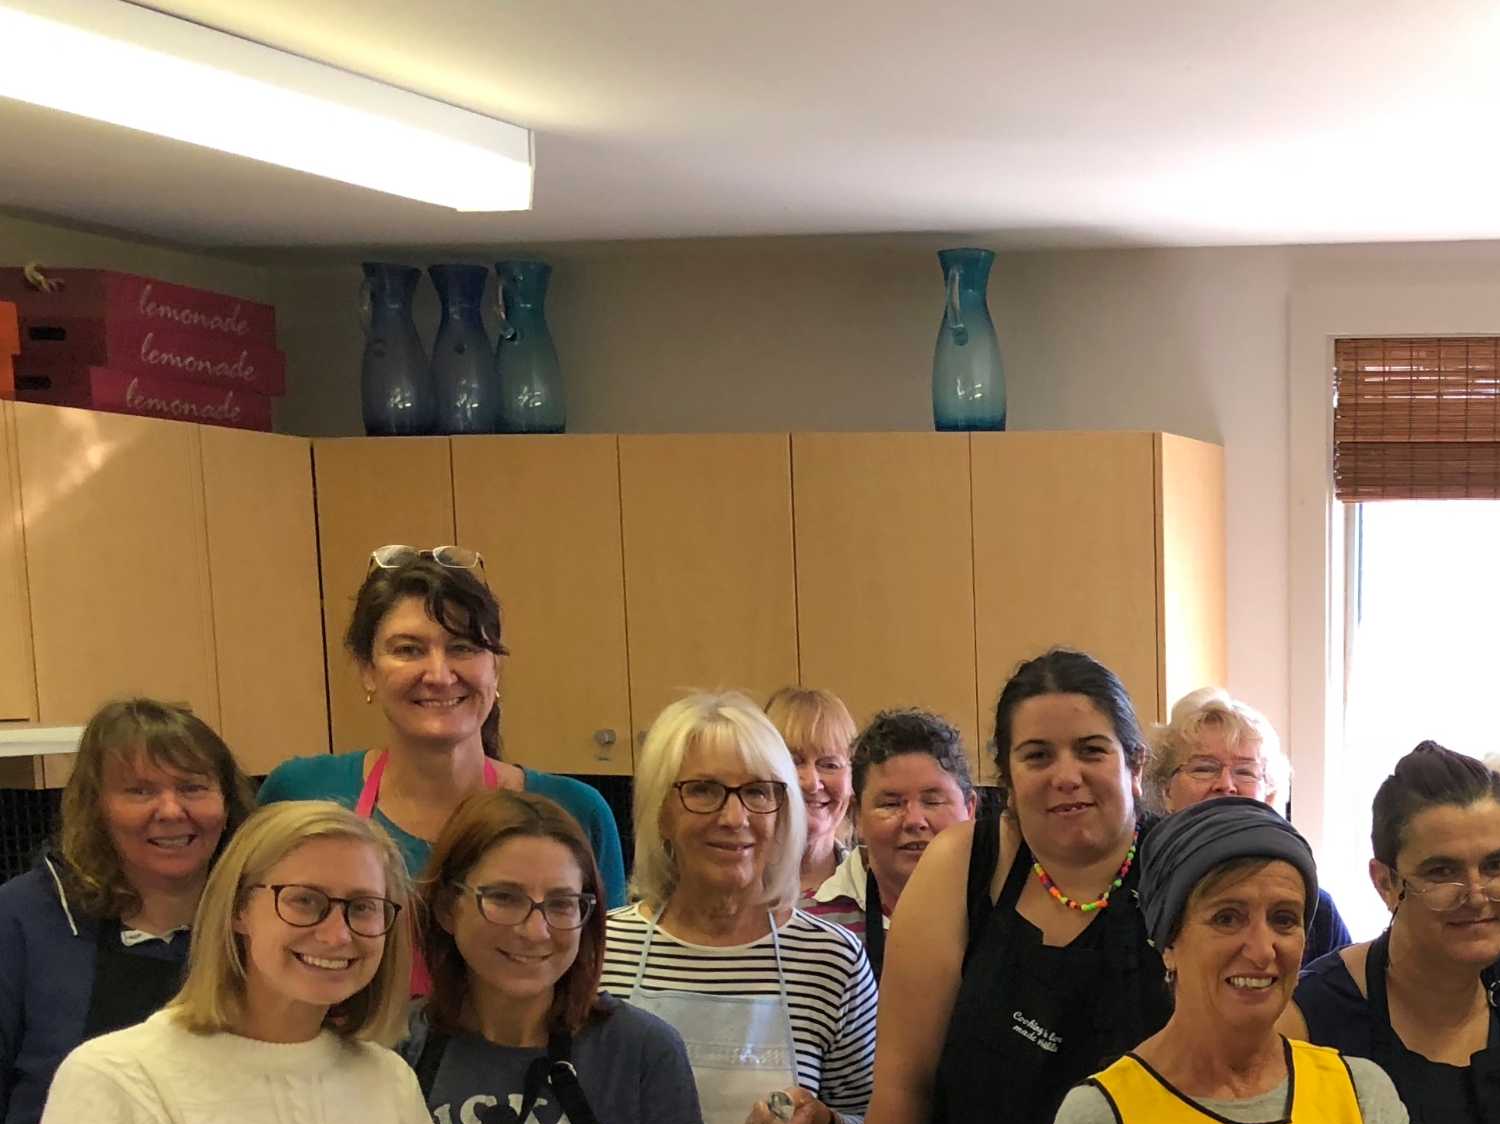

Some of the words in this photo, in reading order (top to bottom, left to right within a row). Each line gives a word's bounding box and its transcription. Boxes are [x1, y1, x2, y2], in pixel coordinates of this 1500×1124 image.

[139, 284, 248, 335] lemonade
[141, 332, 256, 381] lemonade
[126, 377, 241, 422] lemonade
